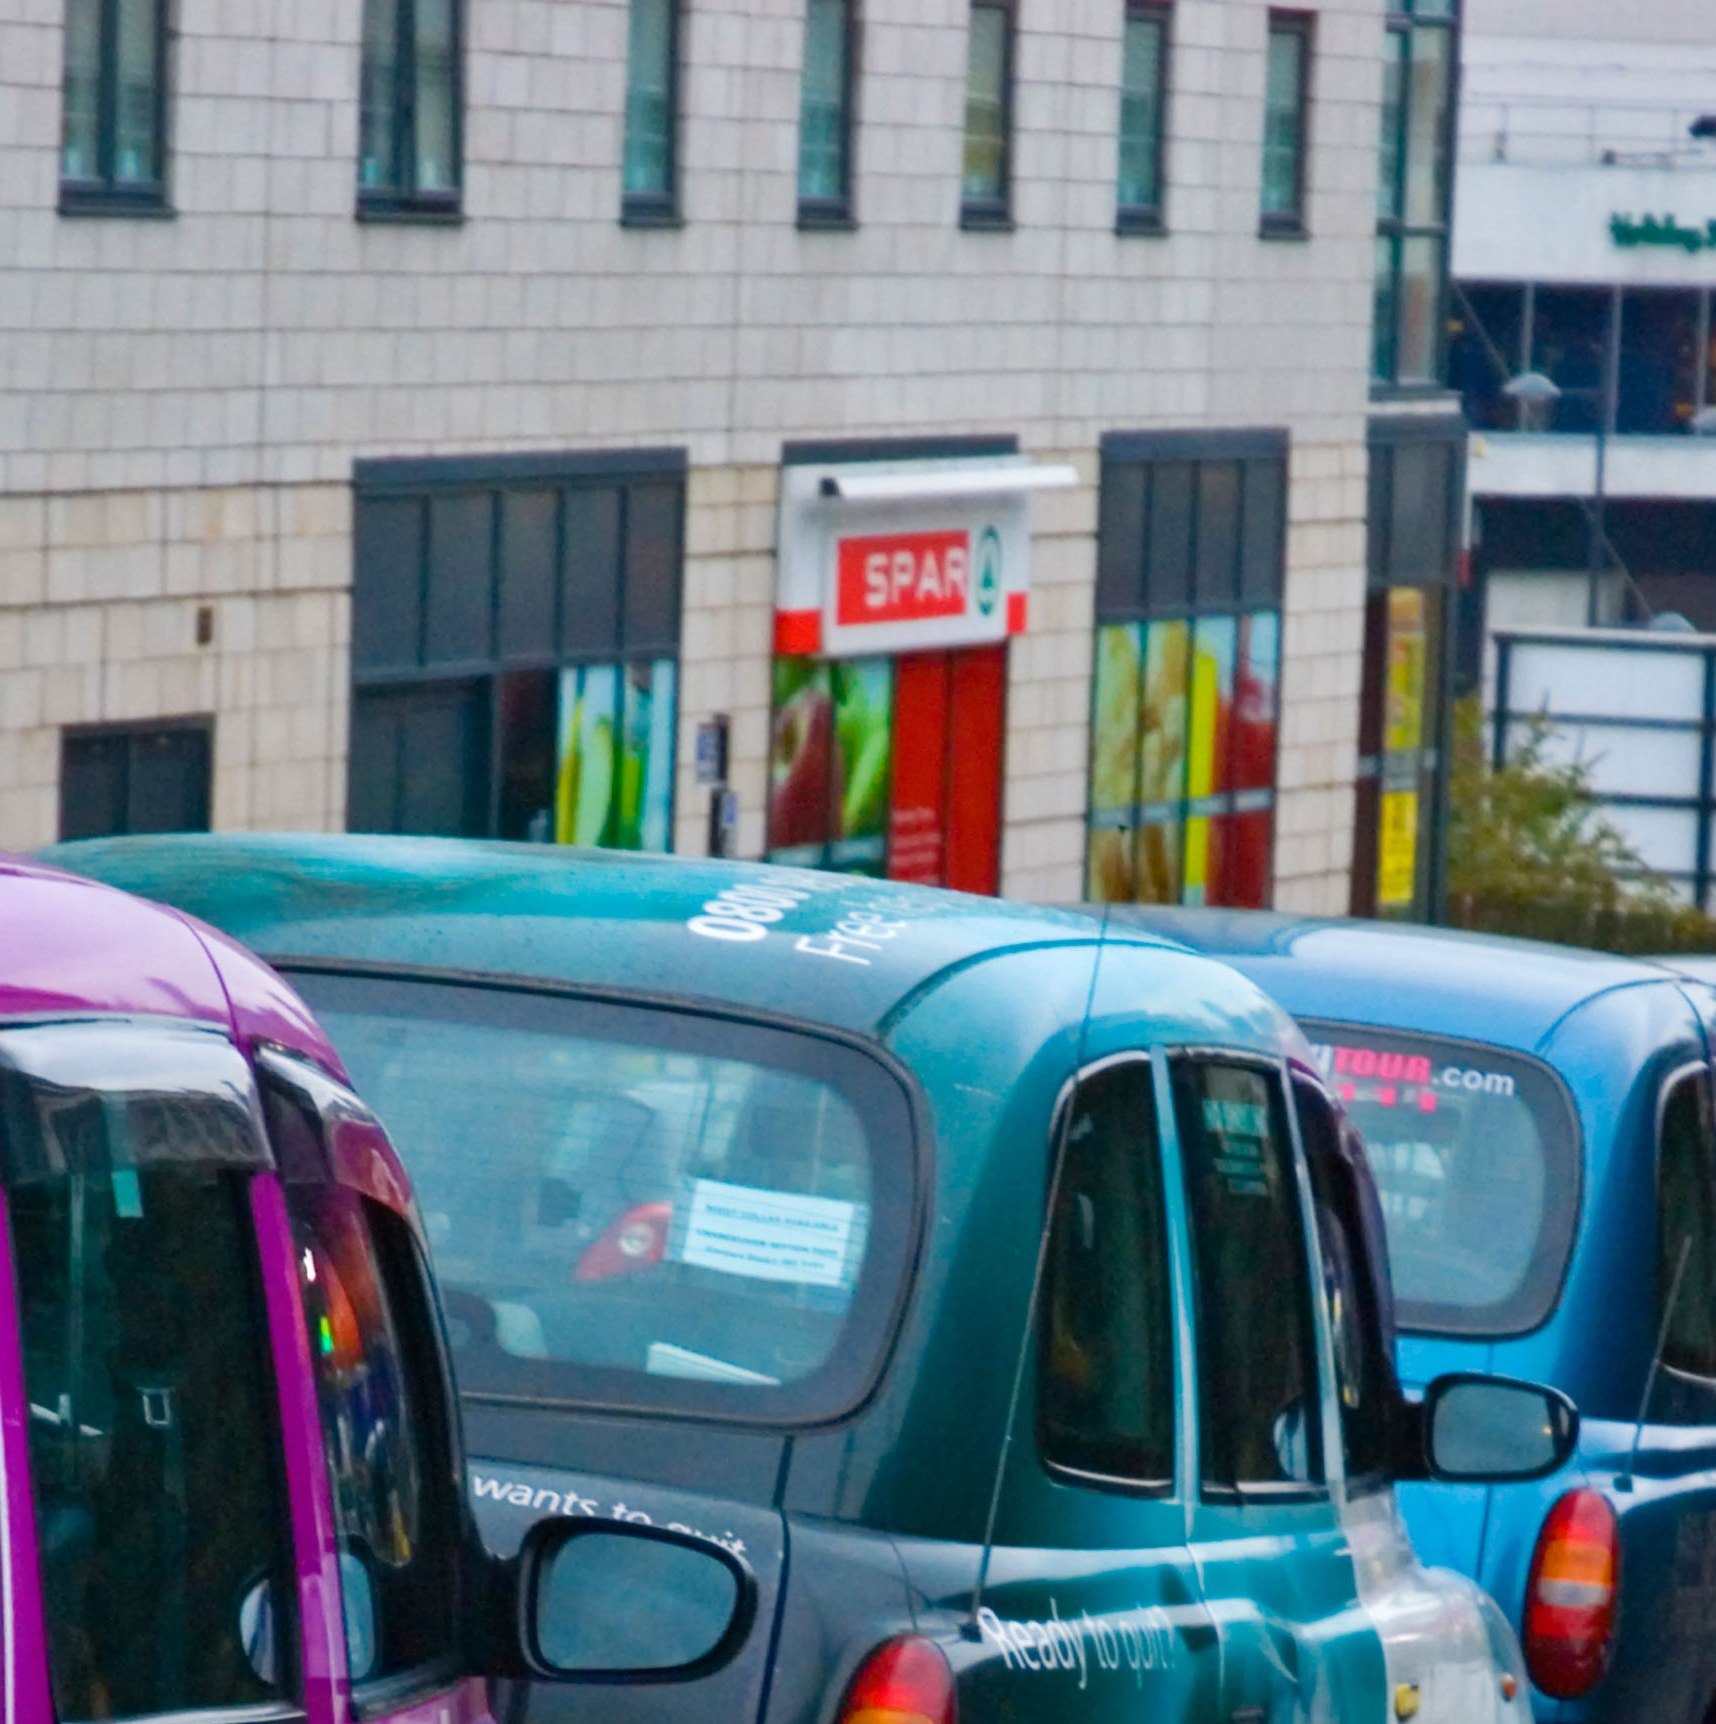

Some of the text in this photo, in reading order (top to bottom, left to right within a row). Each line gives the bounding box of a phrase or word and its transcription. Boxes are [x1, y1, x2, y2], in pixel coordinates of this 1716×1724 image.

[865, 546, 969, 609] SPAR
[471, 1475, 599, 1518] wants
[976, 1596, 1088, 1690] Ready
[1082, 1608, 1119, 1670] to
